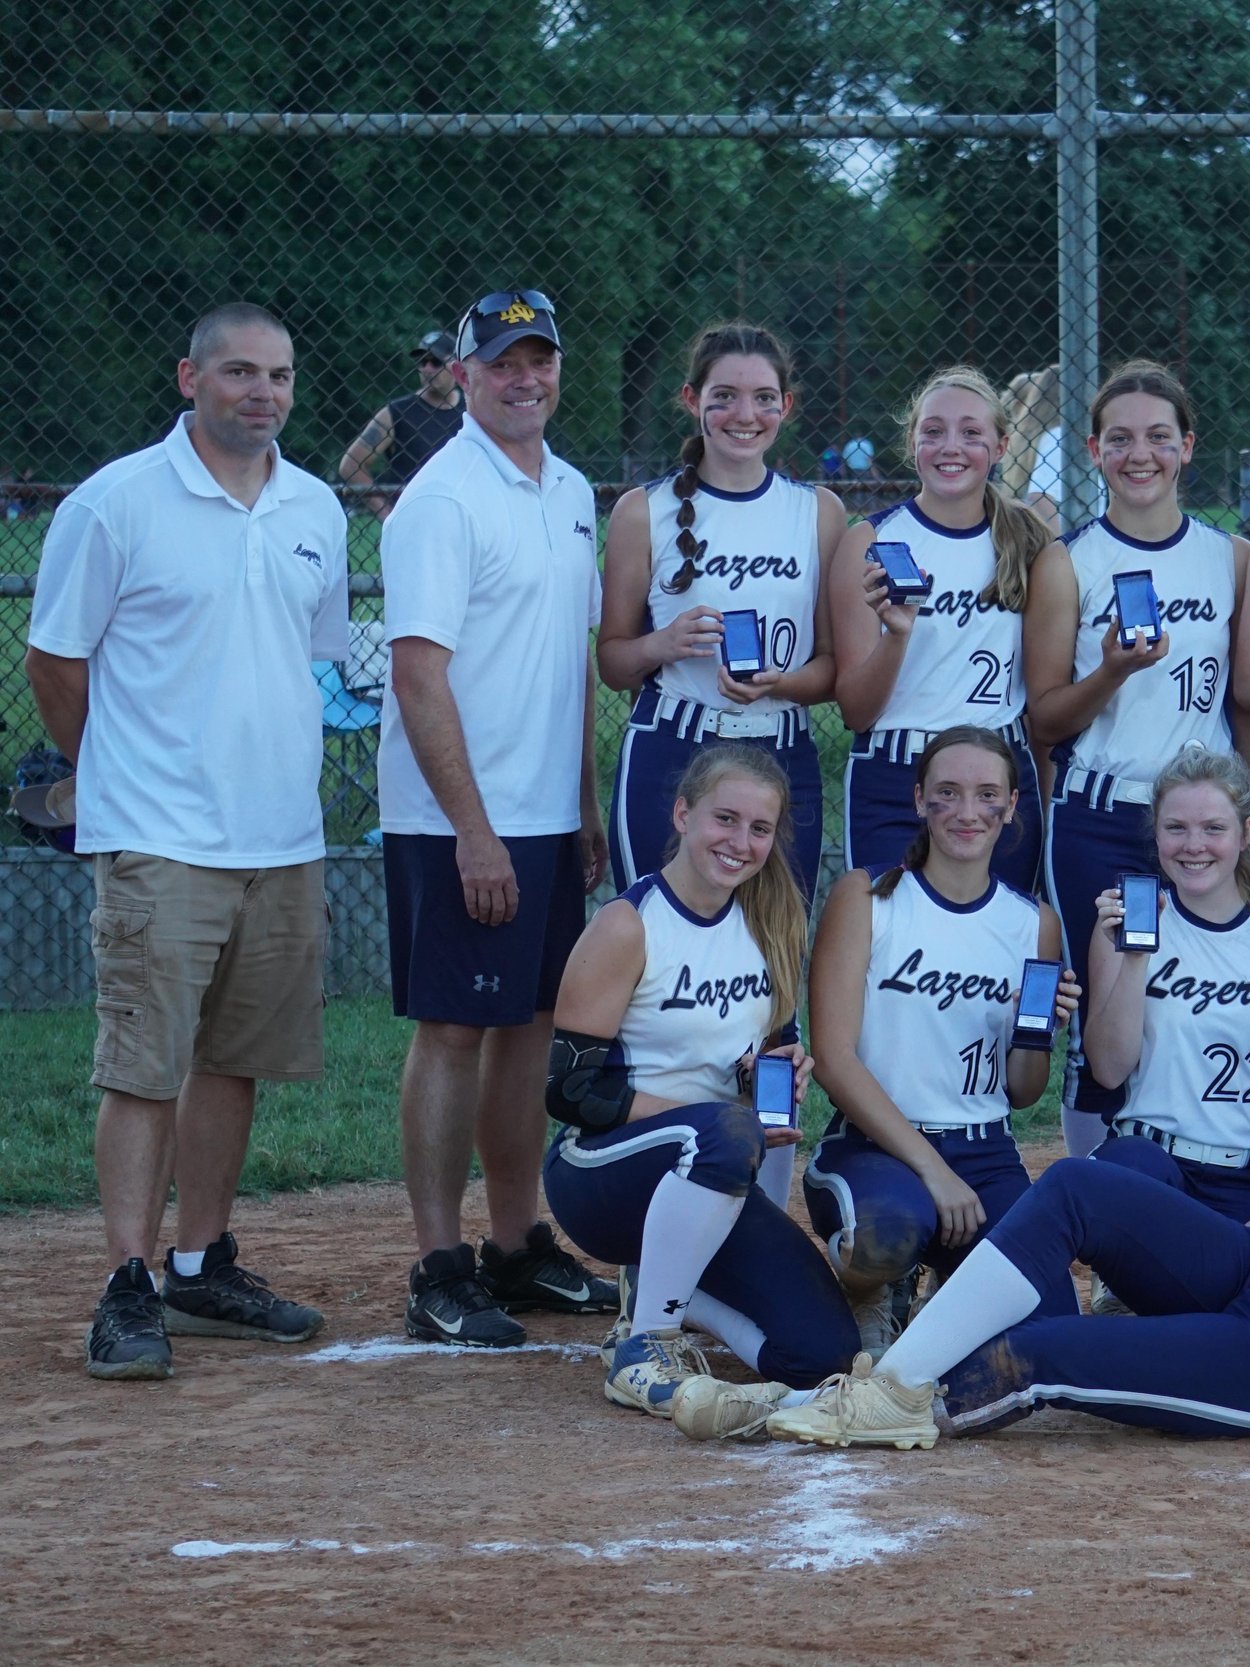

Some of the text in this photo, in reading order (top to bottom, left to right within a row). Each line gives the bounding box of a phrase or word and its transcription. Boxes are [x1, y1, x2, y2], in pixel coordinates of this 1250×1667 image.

[965, 649, 1017, 707] 21
[1168, 655, 1220, 714] 13
[660, 964, 772, 1019] Lazers
[878, 948, 1012, 1011] Lazers
[958, 1038, 999, 1096] 11
